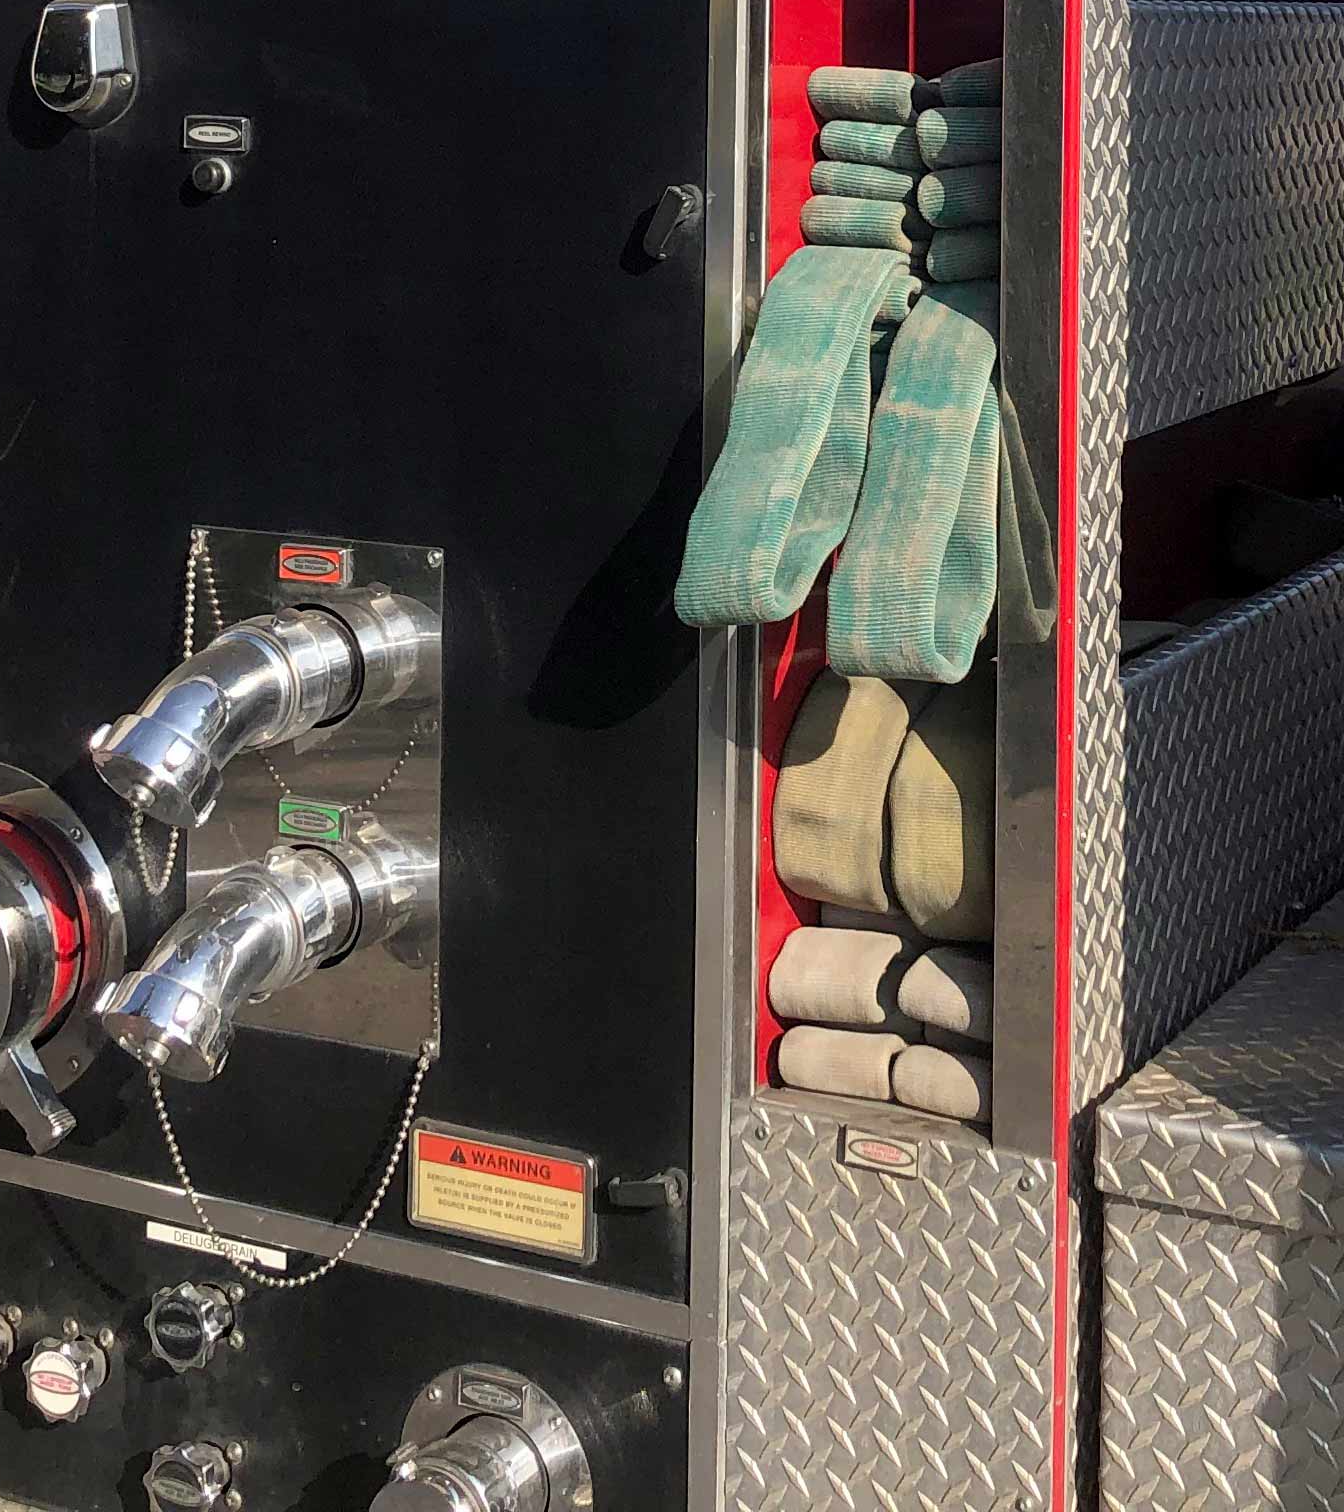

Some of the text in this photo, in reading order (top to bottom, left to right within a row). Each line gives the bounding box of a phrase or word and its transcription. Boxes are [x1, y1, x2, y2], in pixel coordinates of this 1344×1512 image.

[471, 1150, 552, 1181] WARNING
[427, 1172, 456, 1185] SERIOUS
[494, 1186, 517, 1197] DEATH
[518, 1191, 542, 1203] COULD
